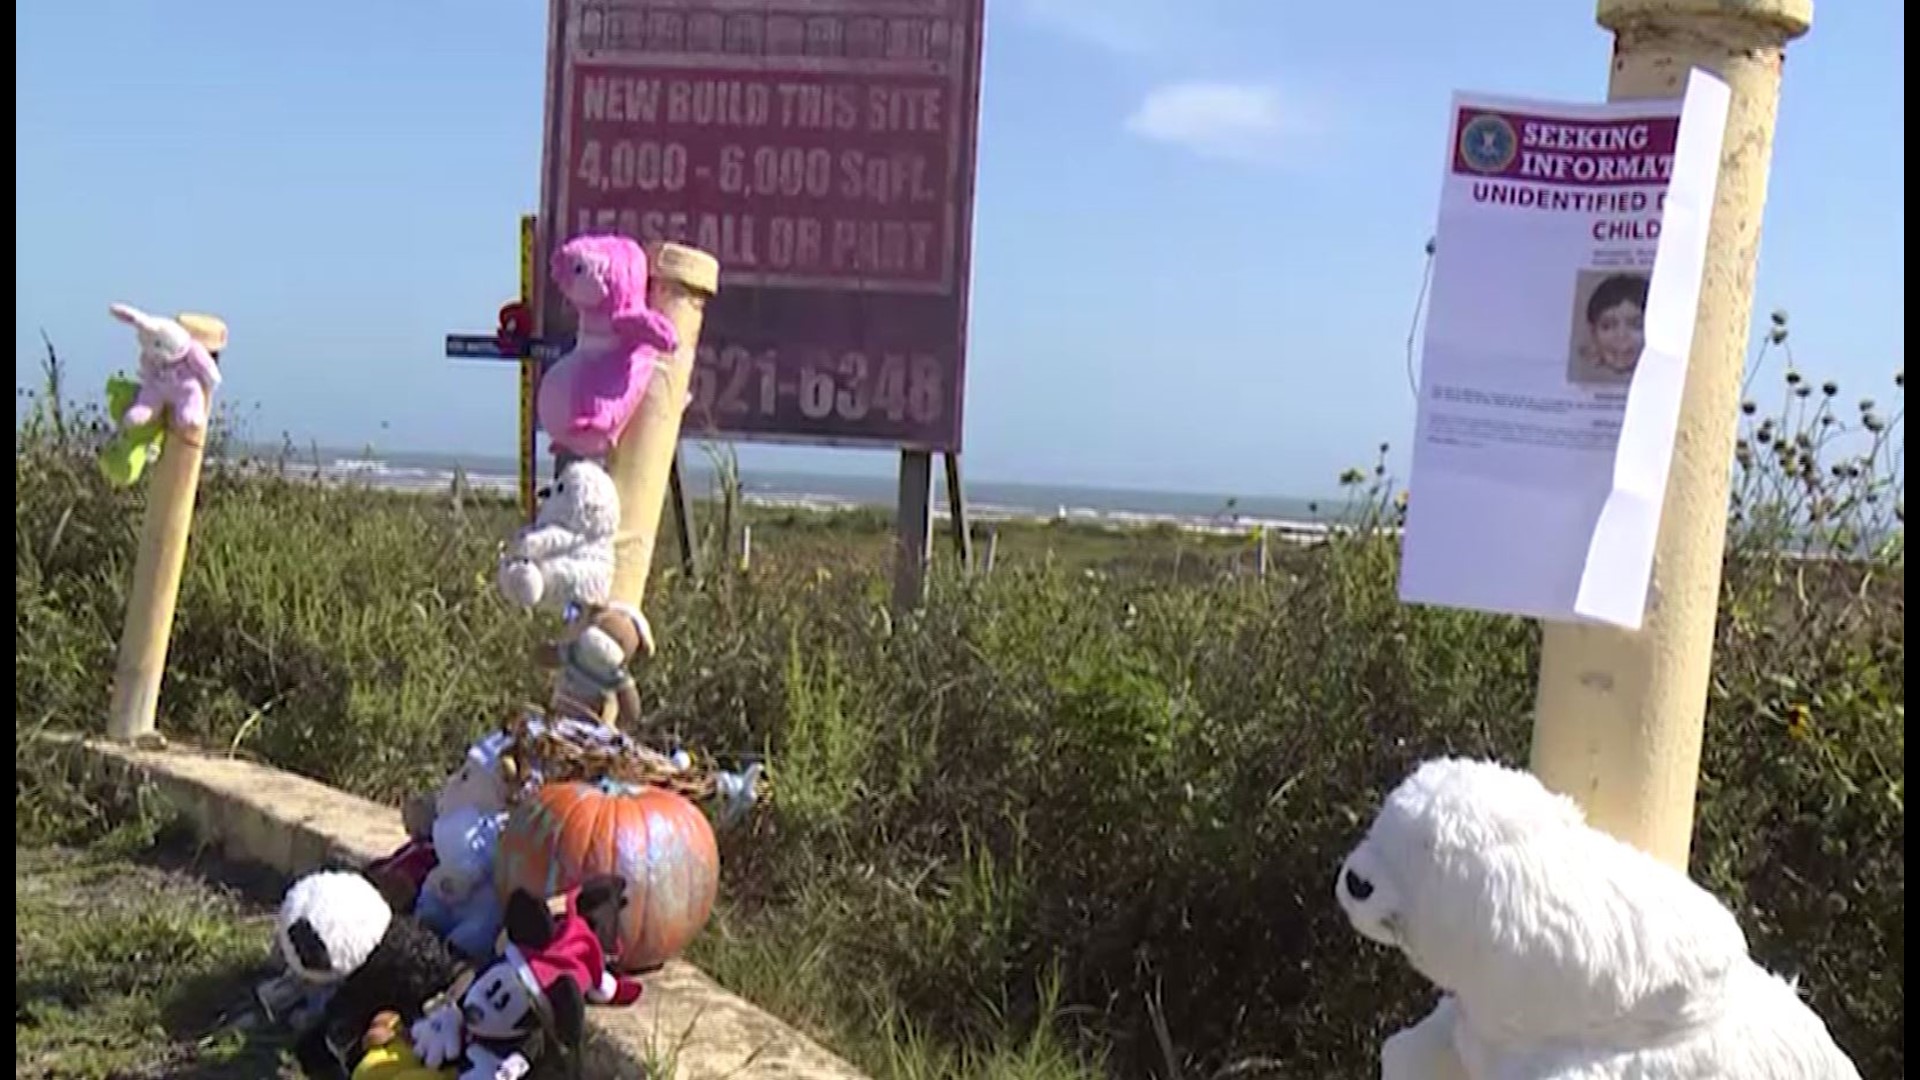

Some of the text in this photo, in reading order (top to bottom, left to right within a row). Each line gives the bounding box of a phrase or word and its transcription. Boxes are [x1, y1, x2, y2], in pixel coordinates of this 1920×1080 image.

[583, 75, 941, 131] NEW BUILD THIS SITE
[1523, 122, 1648, 149] SEEKING
[578, 140, 687, 192] 4,000
[719, 144, 830, 198] 6,000
[1473, 182, 1647, 213] UNIDENTIFIED
[697, 213, 757, 264] ALL
[769, 217, 822, 268] OR
[833, 219, 934, 272] PART
[1592, 219, 1662, 241] CHILD
